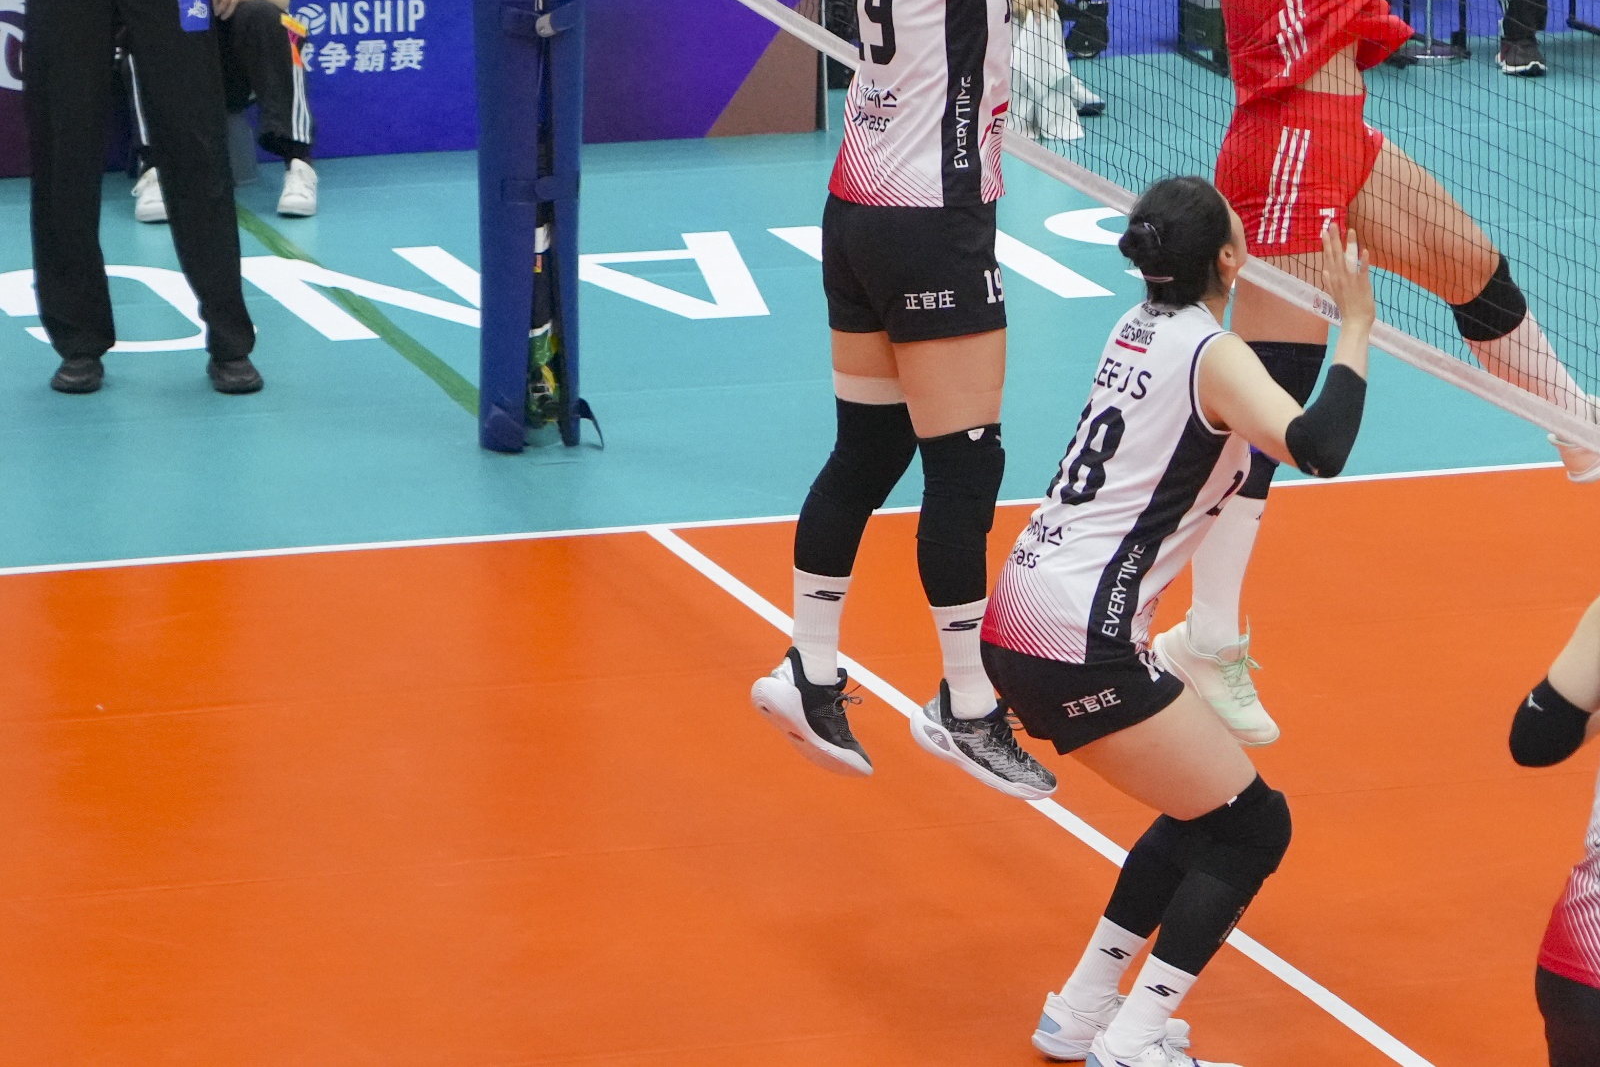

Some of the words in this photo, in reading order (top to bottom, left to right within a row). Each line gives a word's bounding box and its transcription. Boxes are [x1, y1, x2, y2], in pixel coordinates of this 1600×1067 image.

[903, 289, 956, 310] 正官庄
[984, 267, 1004, 304] 19
[1101, 544, 1146, 638] EVERYTIME
[1062, 687, 1122, 718] 正官庄
